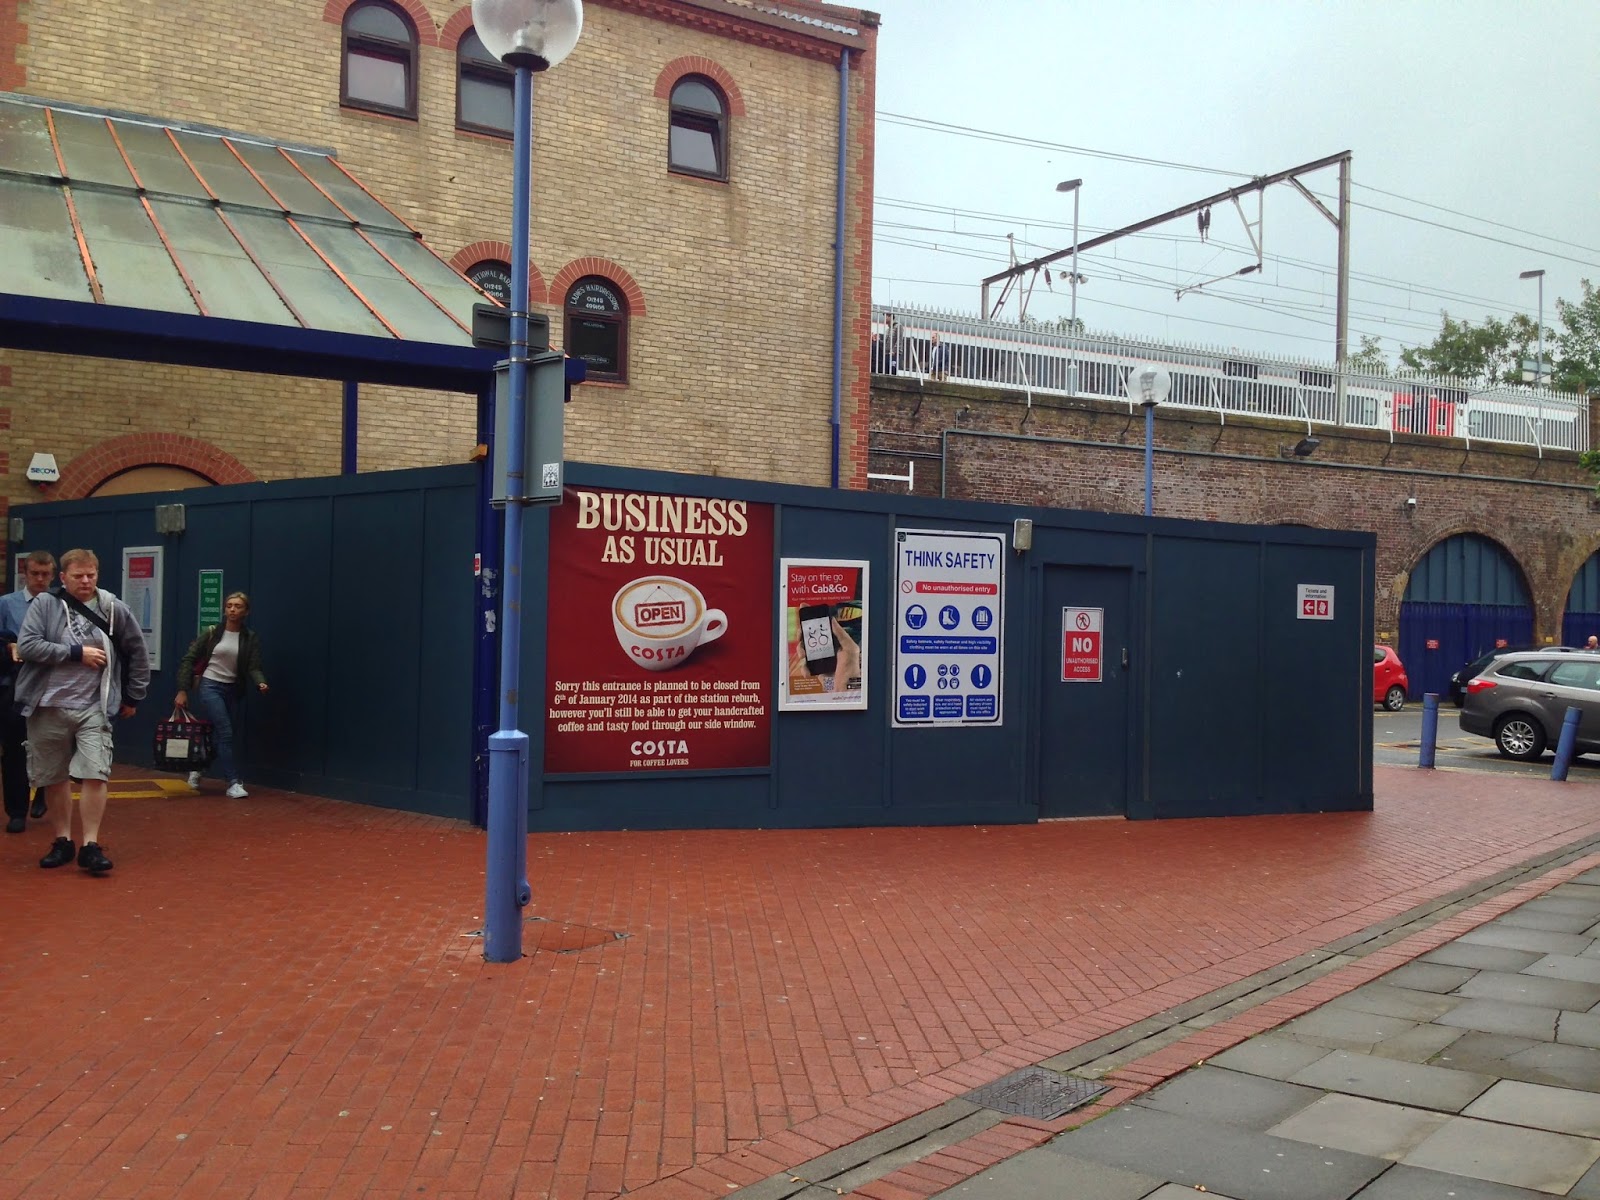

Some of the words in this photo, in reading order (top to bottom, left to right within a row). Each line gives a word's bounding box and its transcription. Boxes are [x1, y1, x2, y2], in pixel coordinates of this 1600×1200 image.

[471, 270, 498, 283] DITIONAL
[570, 286, 586, 305] LADIES
[586, 284, 620, 311] HAIRDRESSING
[30, 467, 56, 475] SECOM
[577, 491, 748, 536] BUSINESS
[601, 535, 635, 564] AS
[644, 537, 724, 566] USUAL
[905, 550, 943, 567] THINK
[945, 551, 995, 569] SAFETY
[791, 573, 806, 583] Stay
[819, 572, 832, 581] the
[833, 573, 843, 583] go
[791, 585, 809, 594] with
[811, 583, 848, 594] Cab&Go
[932, 584, 974, 592] unauthorised
[974, 585, 991, 594] entry
[640, 606, 680, 622] OPEN
[1072, 637, 1093, 653] NO
[630, 645, 685, 661] COSTA
[555, 680, 580, 693] Sorry
[582, 681, 600, 691] this
[602, 681, 641, 691] entrance
[643, 680, 652, 690] is
[653, 680, 688, 692] planned
[690, 681, 699, 690] to
[701, 680, 711, 690] be
[713, 680, 739, 690] closed
[740, 680, 760, 690] from
[554, 694, 566, 704] 6th
[568, 694, 578, 704] of
[578, 694, 616, 706] January
[617, 693, 637, 704] 2014
[639, 695, 651, 704] as
[652, 694, 672, 705] part
[674, 694, 683, 703] of
[684, 693, 698, 703] the
[700, 693, 729, 703] station
[549, 708, 587, 718] however
[588, 707, 612, 720] you'll
[614, 707, 632, 717] still
[634, 707, 644, 717] be
[647, 707, 665, 717] able
[667, 707, 676, 716] to
[678, 707, 692, 718] get
[693, 708, 712, 718] your
[714, 705, 764, 716] handcrafted
[557, 721, 584, 732] coffee
[586, 721, 604, 731] and
[606, 721, 629, 732] tasty
[631, 720, 650, 731] food
[652, 720, 686, 732] through
[688, 721, 702, 730] our
[704, 719, 721, 729] side
[723, 719, 756, 728] window.
[630, 740, 689, 756] COSTA
[629, 759, 642, 767] FOR
[643, 759, 665, 767] COFFEE
[666, 758, 689, 766] LOVERS
